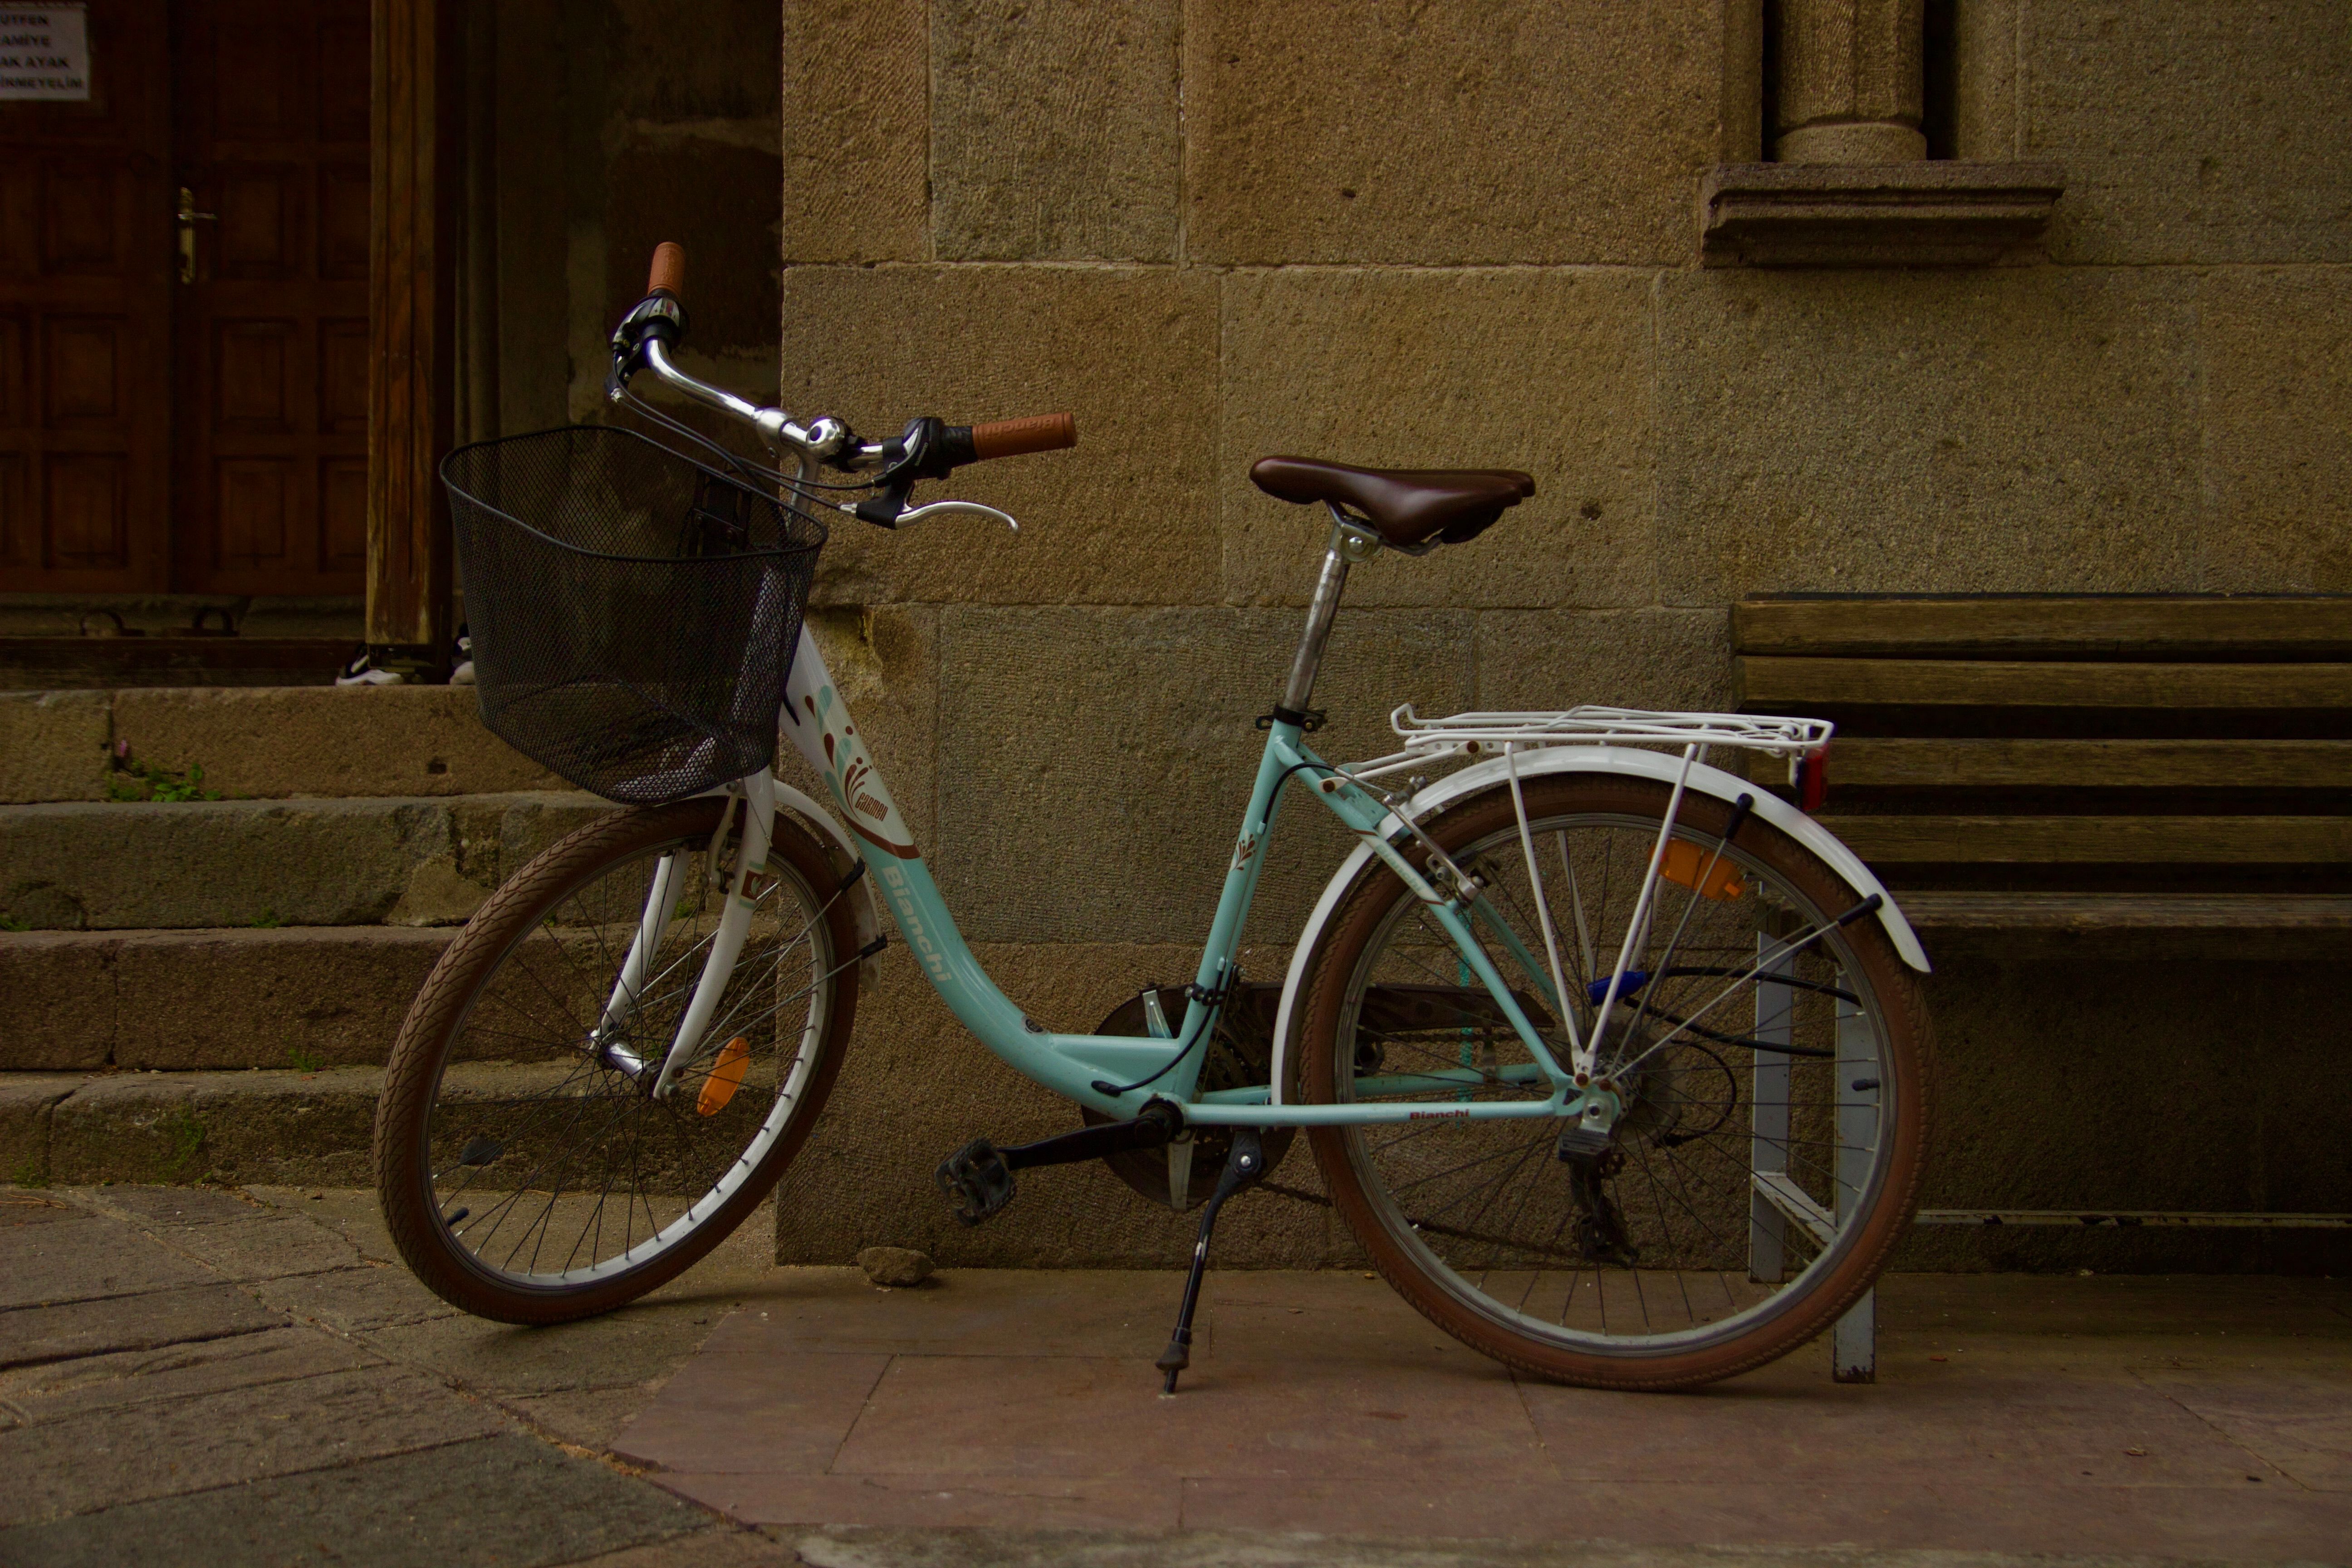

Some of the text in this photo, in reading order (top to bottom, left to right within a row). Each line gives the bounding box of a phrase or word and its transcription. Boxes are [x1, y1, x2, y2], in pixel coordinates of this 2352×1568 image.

[25, 56, 69, 68] AYAK
[882, 866, 952, 981] Bianchi
[1410, 1109, 1470, 1119] Bianchi
